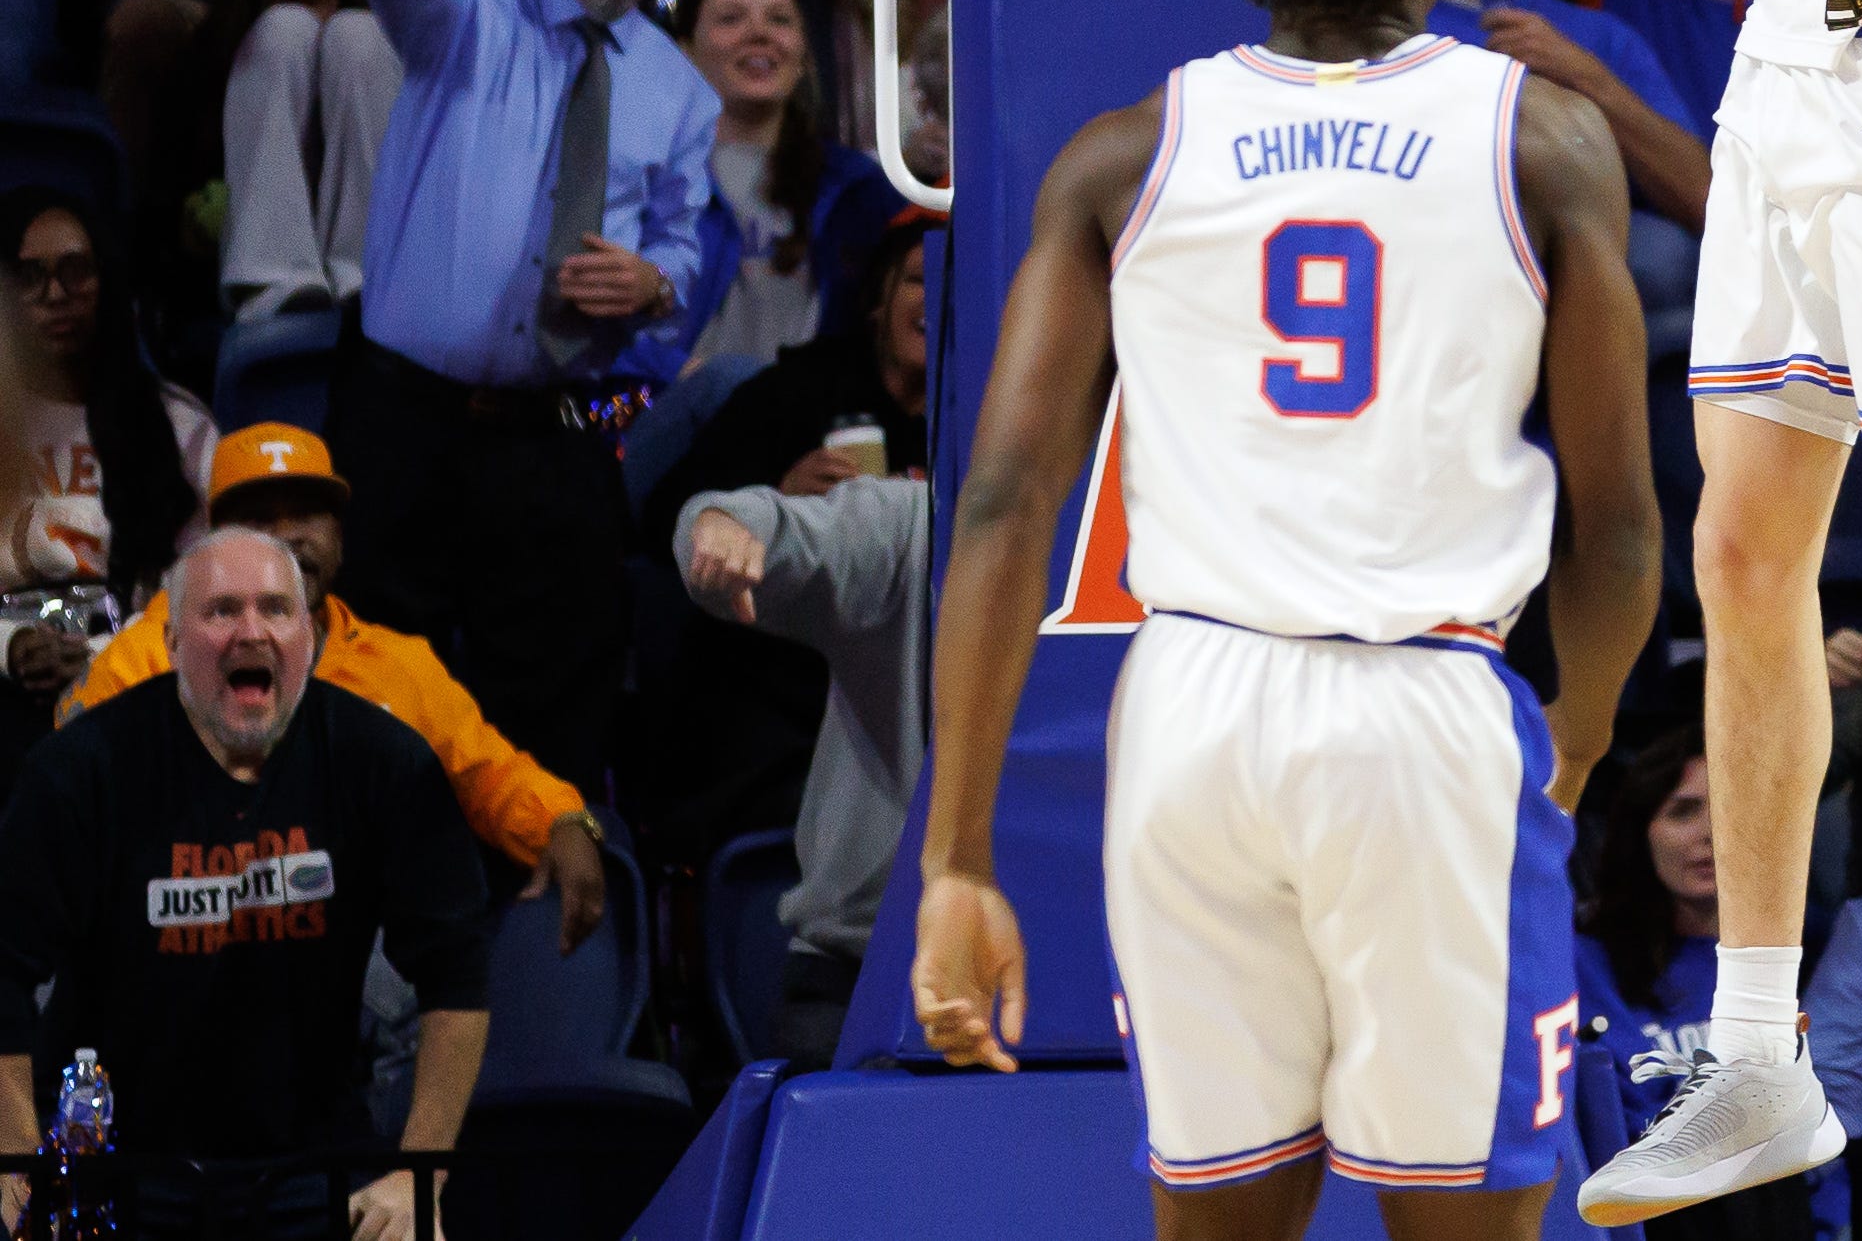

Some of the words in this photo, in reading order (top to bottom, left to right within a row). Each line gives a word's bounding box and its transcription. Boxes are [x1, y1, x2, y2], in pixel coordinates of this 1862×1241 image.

[1233, 120, 1433, 180] CHINYELU
[1260, 219, 1384, 419] 9
[259, 441, 293, 472] T
[159, 886, 221, 917] JUST
[1532, 991, 1579, 1131] F
